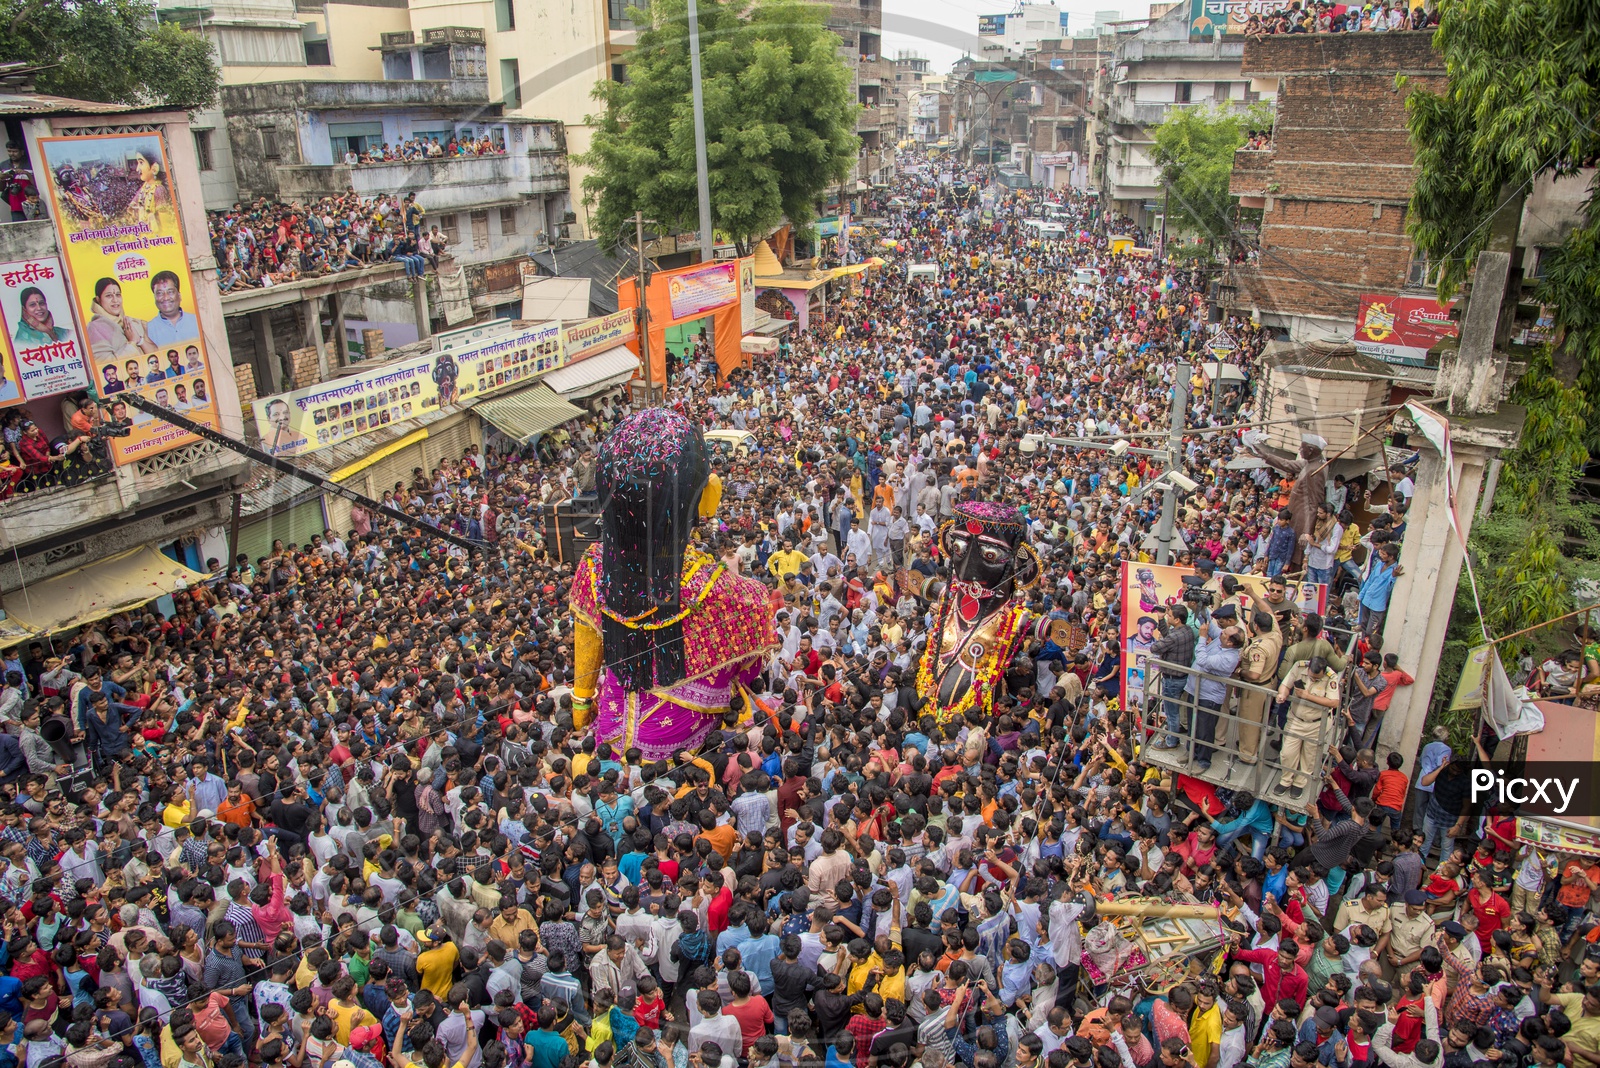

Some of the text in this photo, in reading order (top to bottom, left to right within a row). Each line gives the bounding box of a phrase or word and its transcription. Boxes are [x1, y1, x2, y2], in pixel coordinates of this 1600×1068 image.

[69, 232, 84, 243] हम
[102, 244, 116, 255] हम
[116, 256, 146, 271] हार्दिक
[1, 263, 55, 288] हार्दीक
[118, 270, 149, 282] स्वागत
[568, 325, 600, 343] विशाल
[19, 339, 77, 367] स्वागत
[22, 369, 42, 380] आभा
[68, 358, 84, 371] पांडे
[366, 379, 373, 390] व
[458, 349, 479, 364] समस्त
